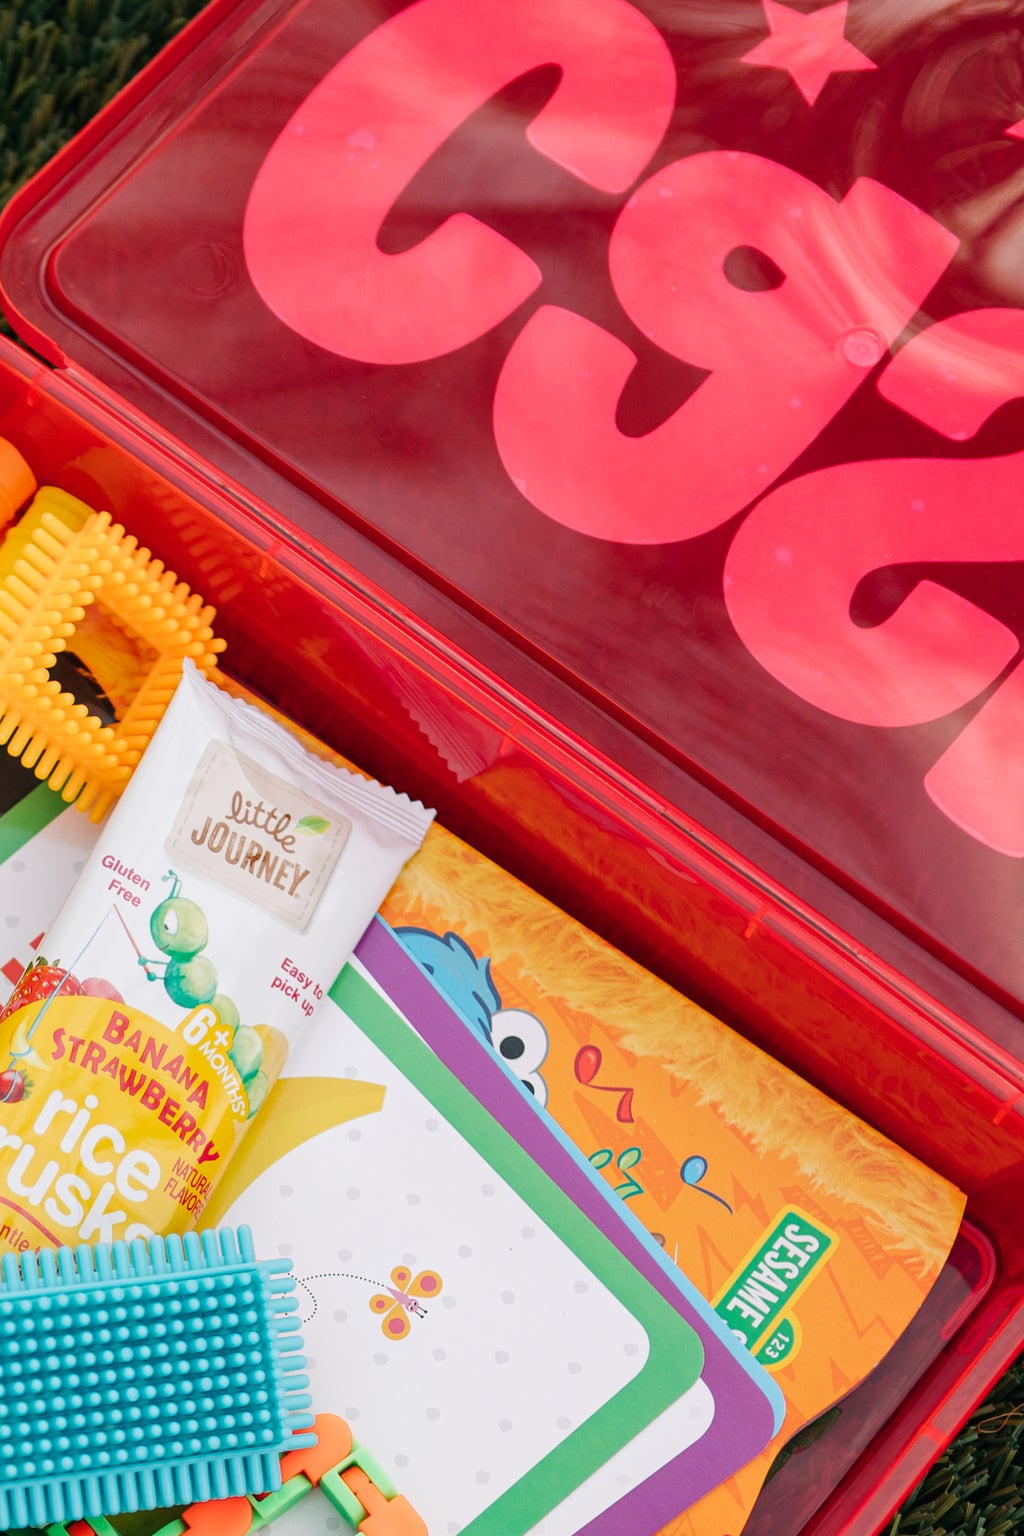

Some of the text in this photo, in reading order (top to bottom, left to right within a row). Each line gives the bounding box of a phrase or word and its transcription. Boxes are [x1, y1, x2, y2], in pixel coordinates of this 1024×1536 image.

[225, 790, 296, 854] little
[101, 855, 151, 891] Gluten
[191, 816, 311, 897] JOURNEY
[108, 879, 142, 907] Free
[271, 976, 314, 1017] pick up
[280, 957, 323, 1000] Easy to
[182, 1008, 230, 1047] 6+
[102, 1010, 210, 1110] BANANA
[51, 1027, 220, 1165] STRAWBERRY
[33, 1089, 161, 1202] rice
[726, 1223, 820, 1329] SESAME
[765, 1332, 790, 1359] 123
